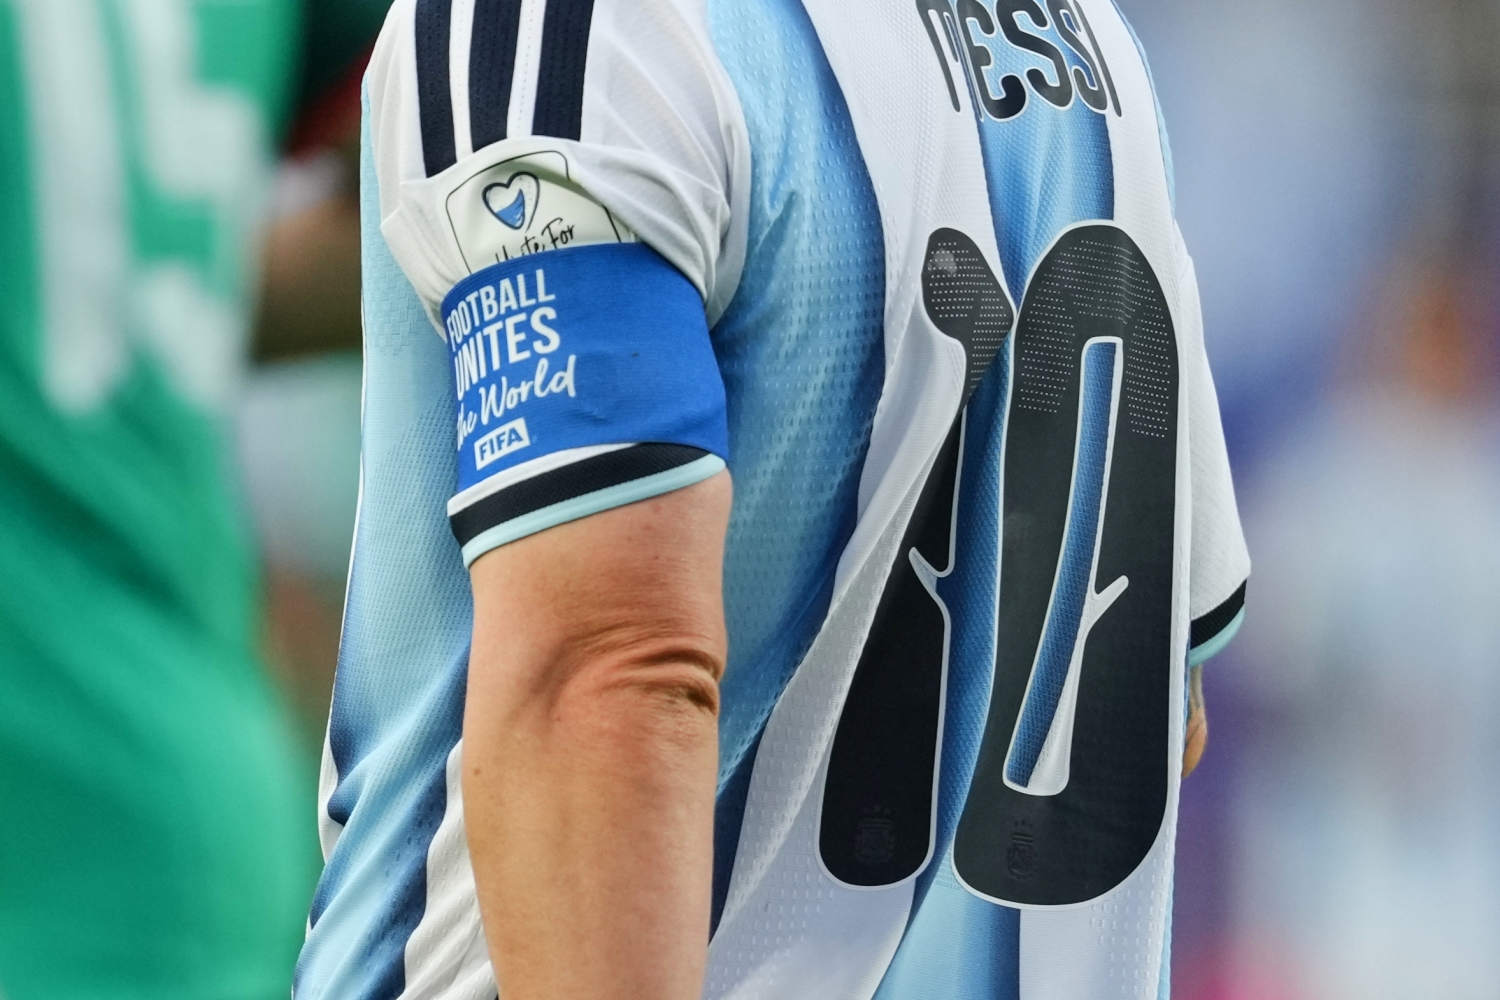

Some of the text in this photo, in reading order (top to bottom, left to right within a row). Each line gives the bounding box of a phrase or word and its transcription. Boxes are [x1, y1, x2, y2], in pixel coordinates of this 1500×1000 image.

[541, 217, 575, 250] For
[446, 268, 556, 352] FOOTBALL
[454, 306, 561, 401] UNITES
[479, 354, 576, 425] World
[478, 427, 524, 462] FIFA
[816, 219, 1181, 911] 10
